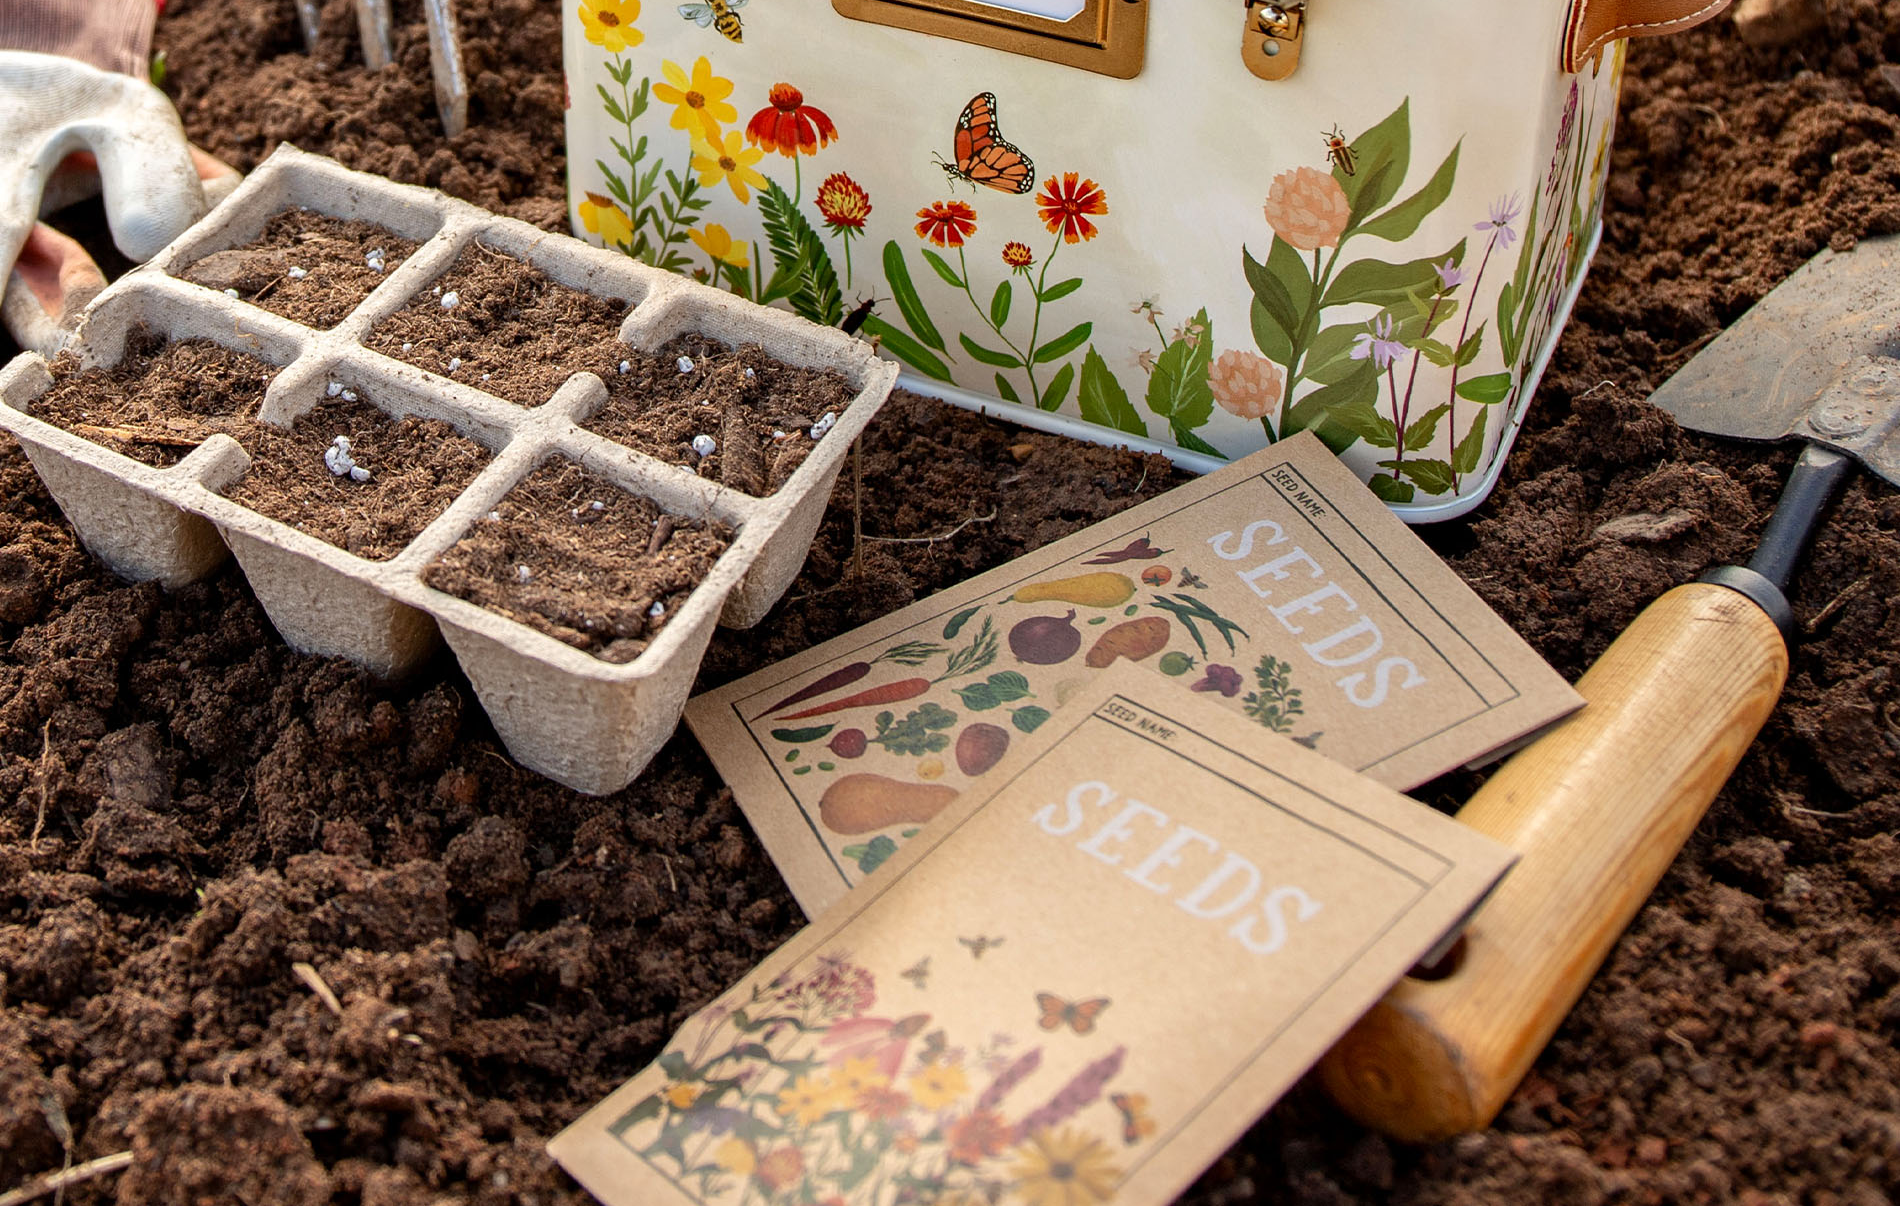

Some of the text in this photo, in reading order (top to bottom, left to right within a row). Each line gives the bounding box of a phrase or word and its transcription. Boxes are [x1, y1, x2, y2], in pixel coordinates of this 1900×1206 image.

[1271, 469, 1299, 491] SEED
[1207, 519, 1427, 708] SEEDS
[1103, 702, 1137, 722] SEED
[1031, 780, 1324, 955] SEEDS
